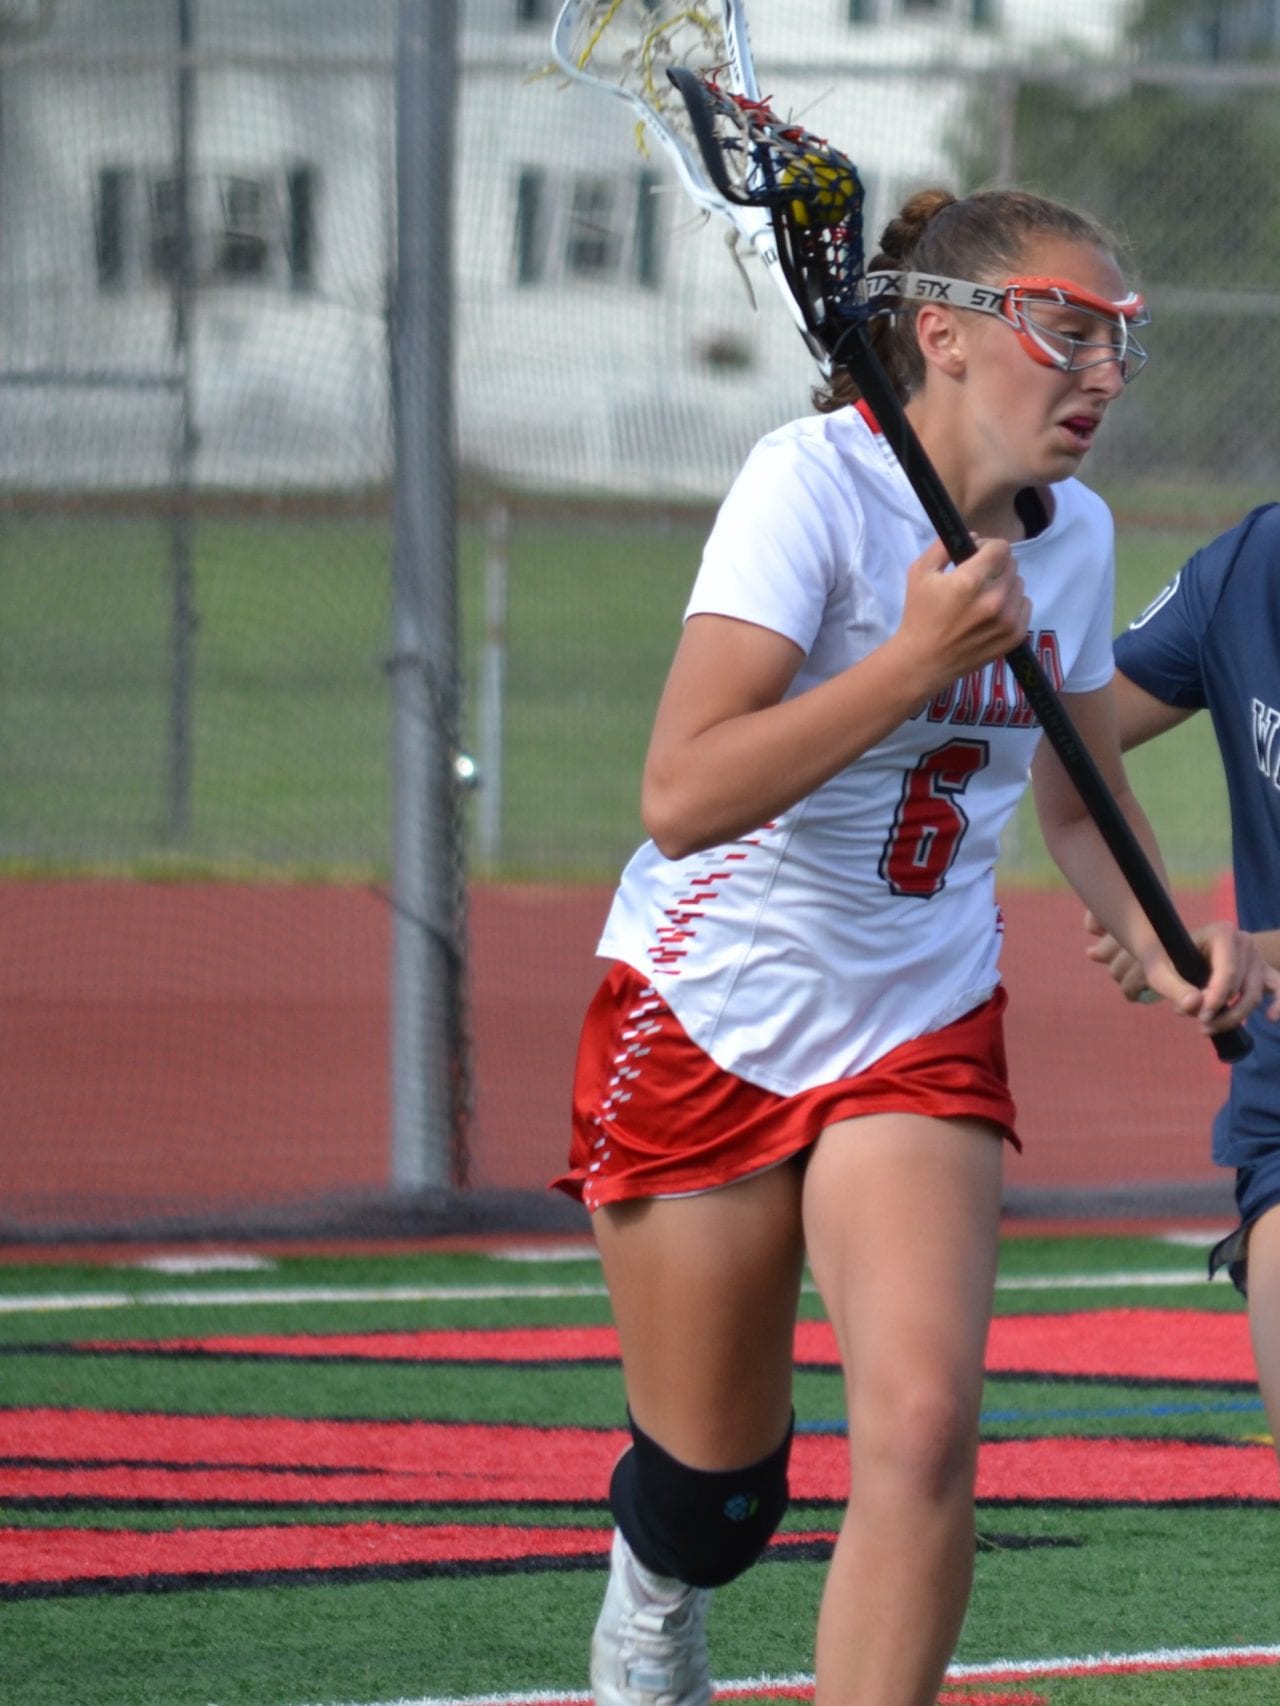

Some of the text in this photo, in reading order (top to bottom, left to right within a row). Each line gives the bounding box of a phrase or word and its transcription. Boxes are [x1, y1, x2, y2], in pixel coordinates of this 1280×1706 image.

[915, 279, 952, 300] STX
[970, 288, 1005, 309] ST
[905, 629, 1064, 729] NAD
[877, 736, 991, 900] 6
